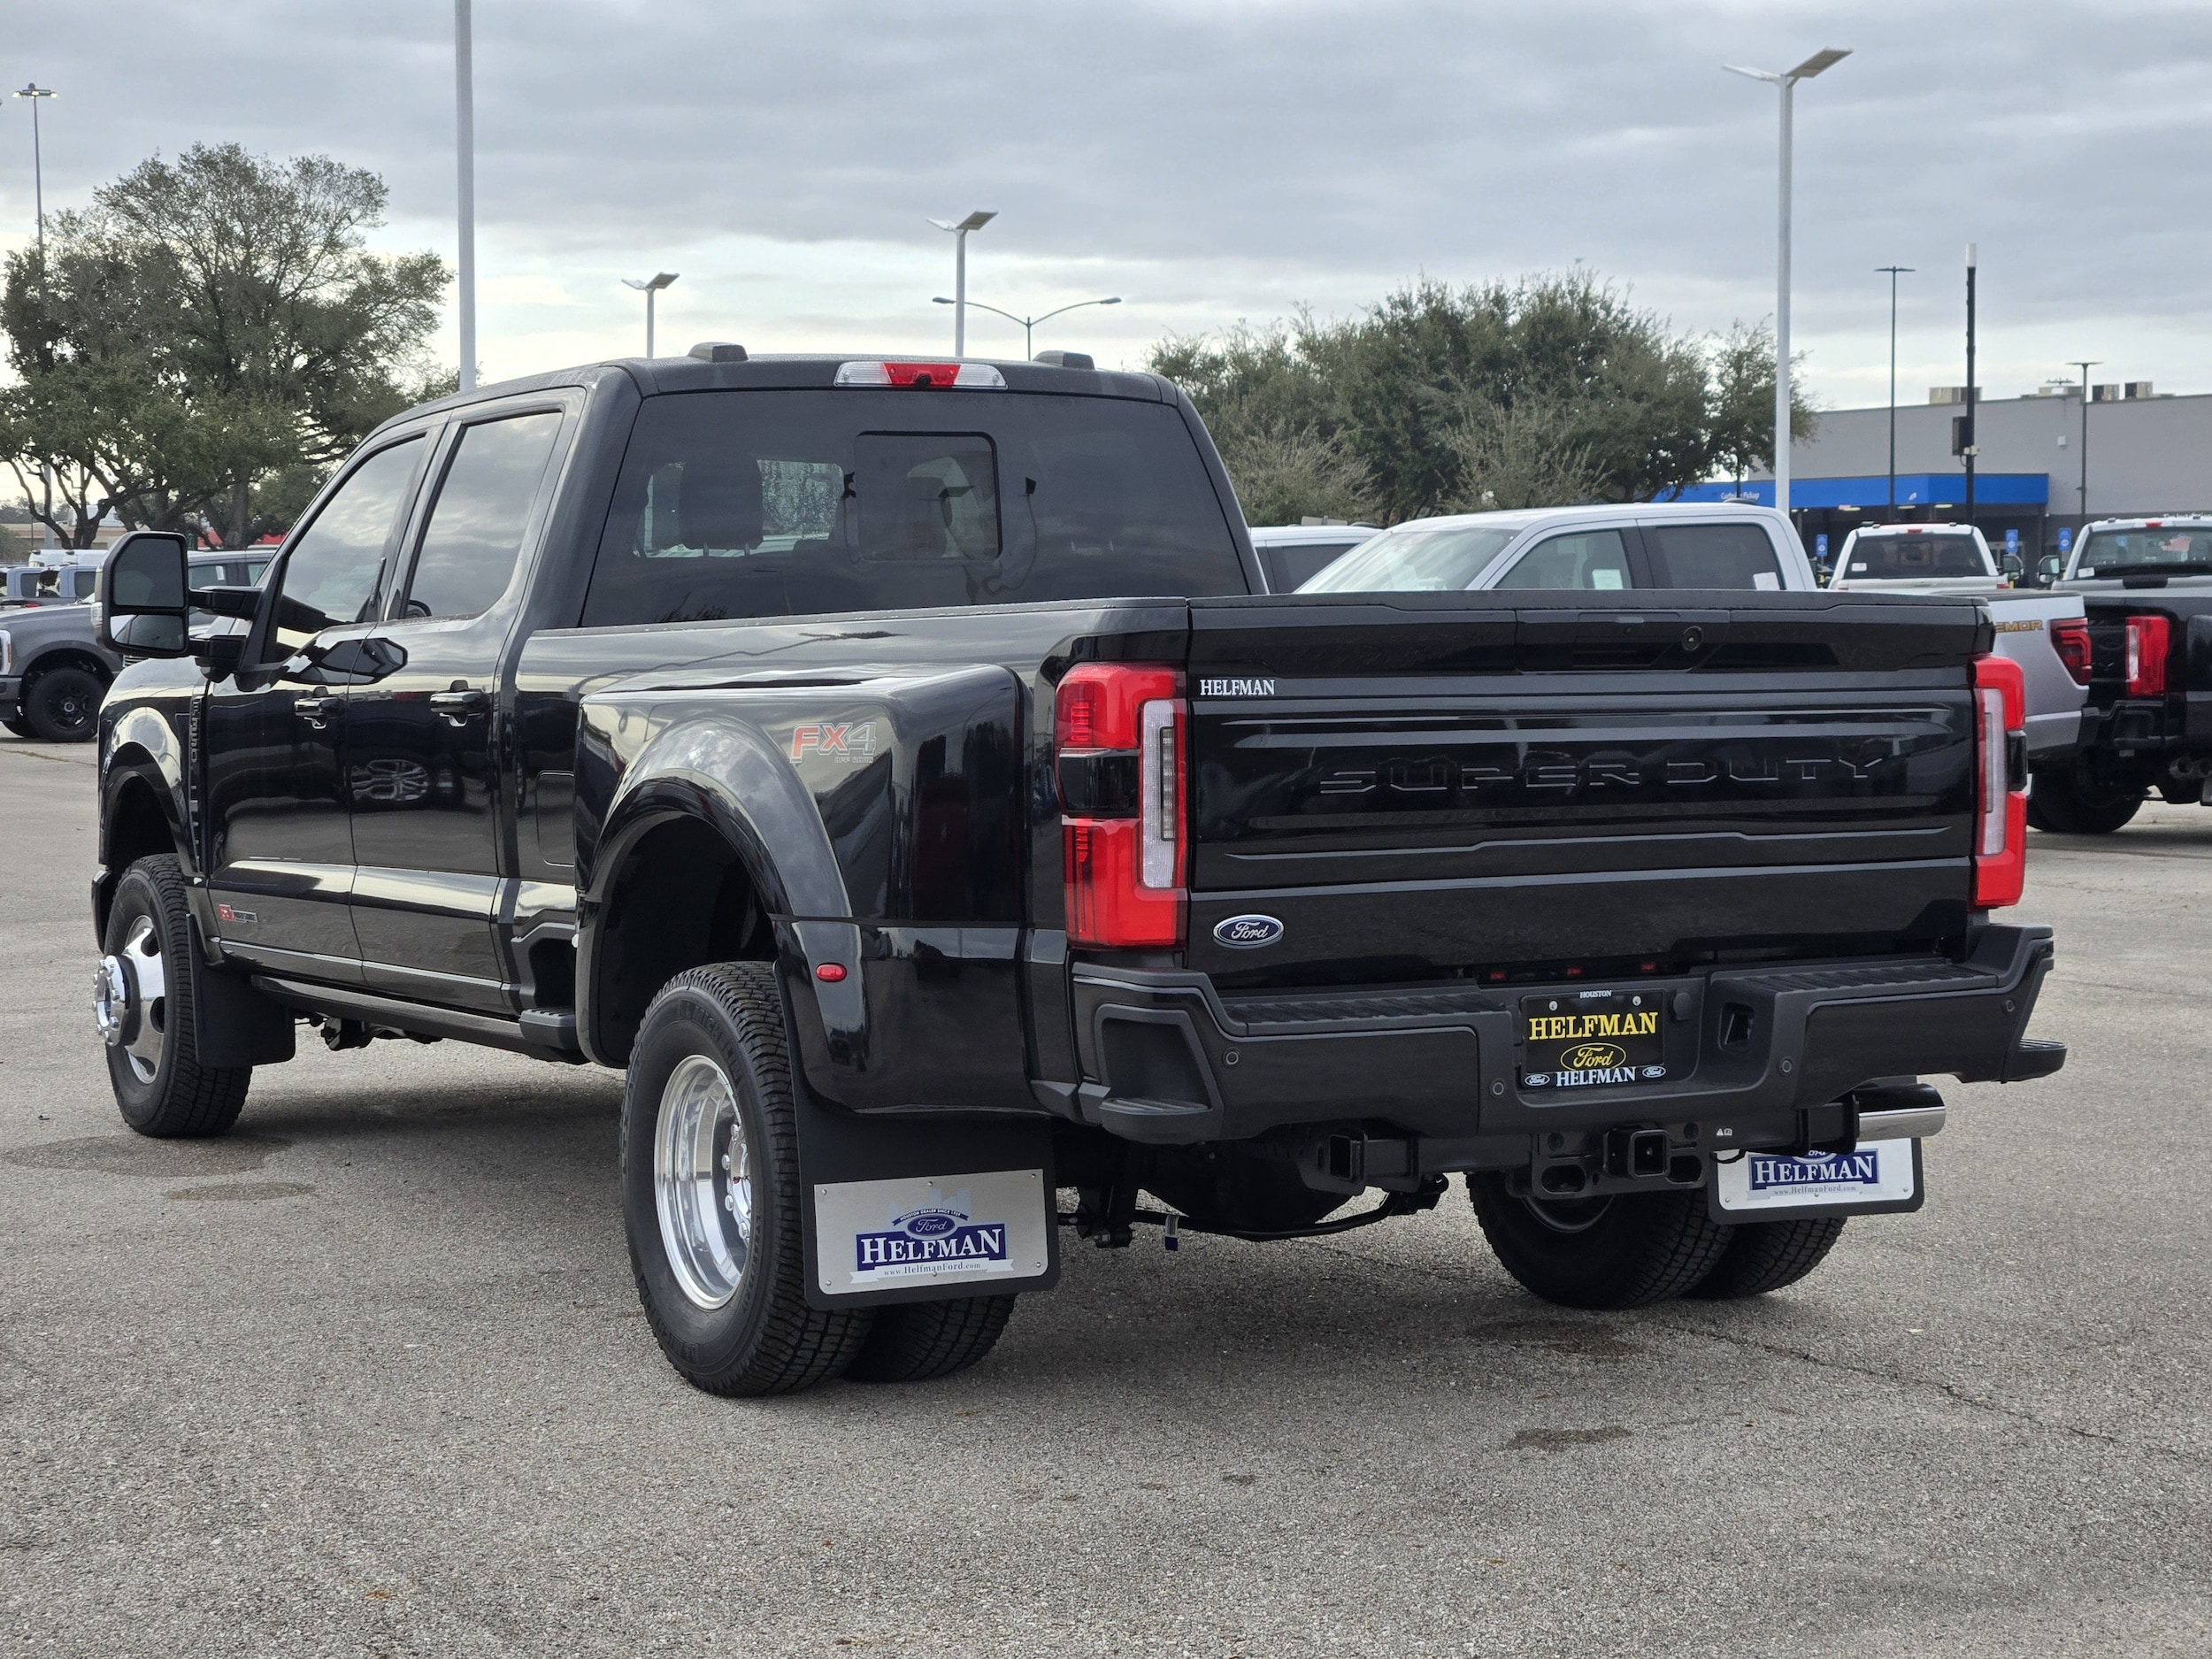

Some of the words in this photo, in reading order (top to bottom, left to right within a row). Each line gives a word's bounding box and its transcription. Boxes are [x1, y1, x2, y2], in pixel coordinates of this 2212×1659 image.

[1995, 619, 2044, 633] EMOR
[1200, 680, 1275, 695] HELFMAN
[789, 721, 877, 764] FX4
[1319, 763, 1640, 795] SUPER
[1666, 757, 1884, 785] DUTY
[1231, 921, 1270, 939] Ford
[1579, 990, 1612, 999] HOUSTON
[1528, 1011, 1659, 1041] HELFMAN
[1572, 1046, 1615, 1068] Ford
[1555, 1066, 1637, 1087] HELFMAN
[1754, 1155, 1874, 1184] HELFMAN
[916, 1218, 948, 1233] Ford
[861, 1229, 1002, 1264] HELFMAN
[884, 1261, 981, 1276] www.HelfmanFord.com
